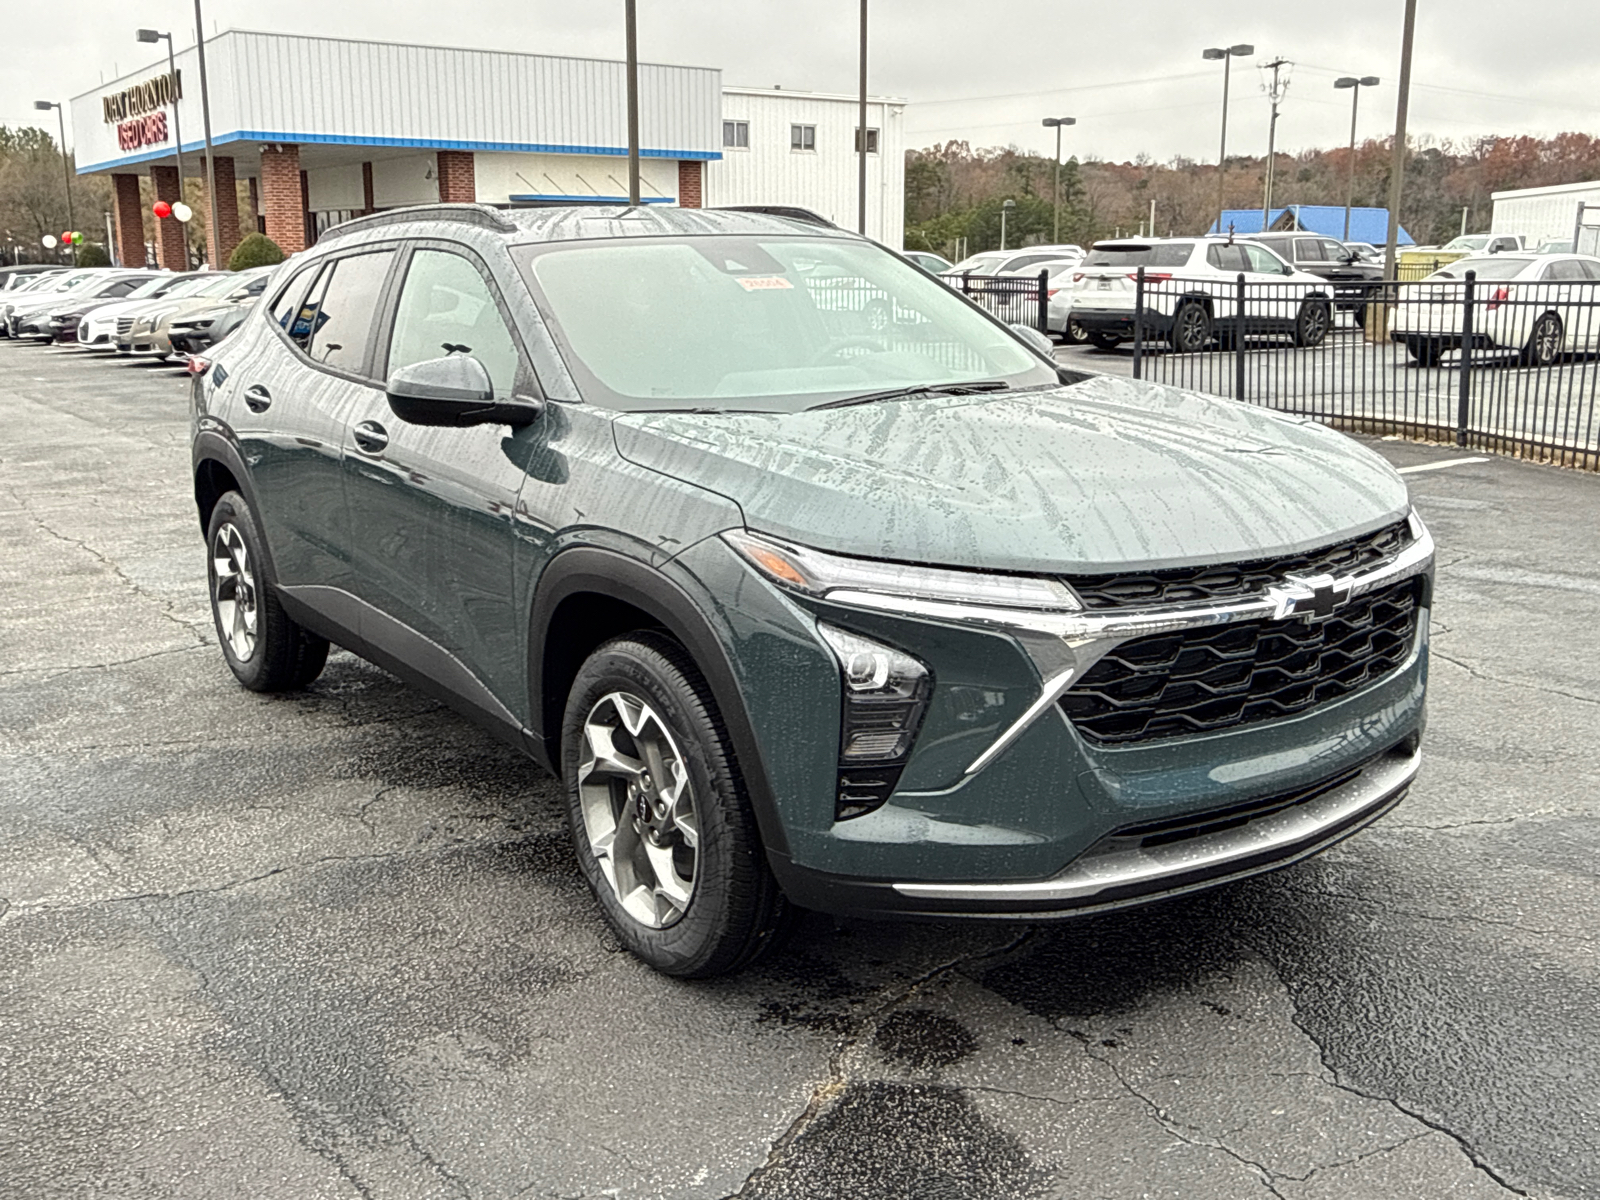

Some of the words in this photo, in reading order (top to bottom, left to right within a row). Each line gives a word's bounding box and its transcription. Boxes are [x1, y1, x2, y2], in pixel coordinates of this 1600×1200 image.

[102, 91, 126, 124] JOHN
[117, 119, 142, 151] USED
[140, 111, 168, 145] CARS
